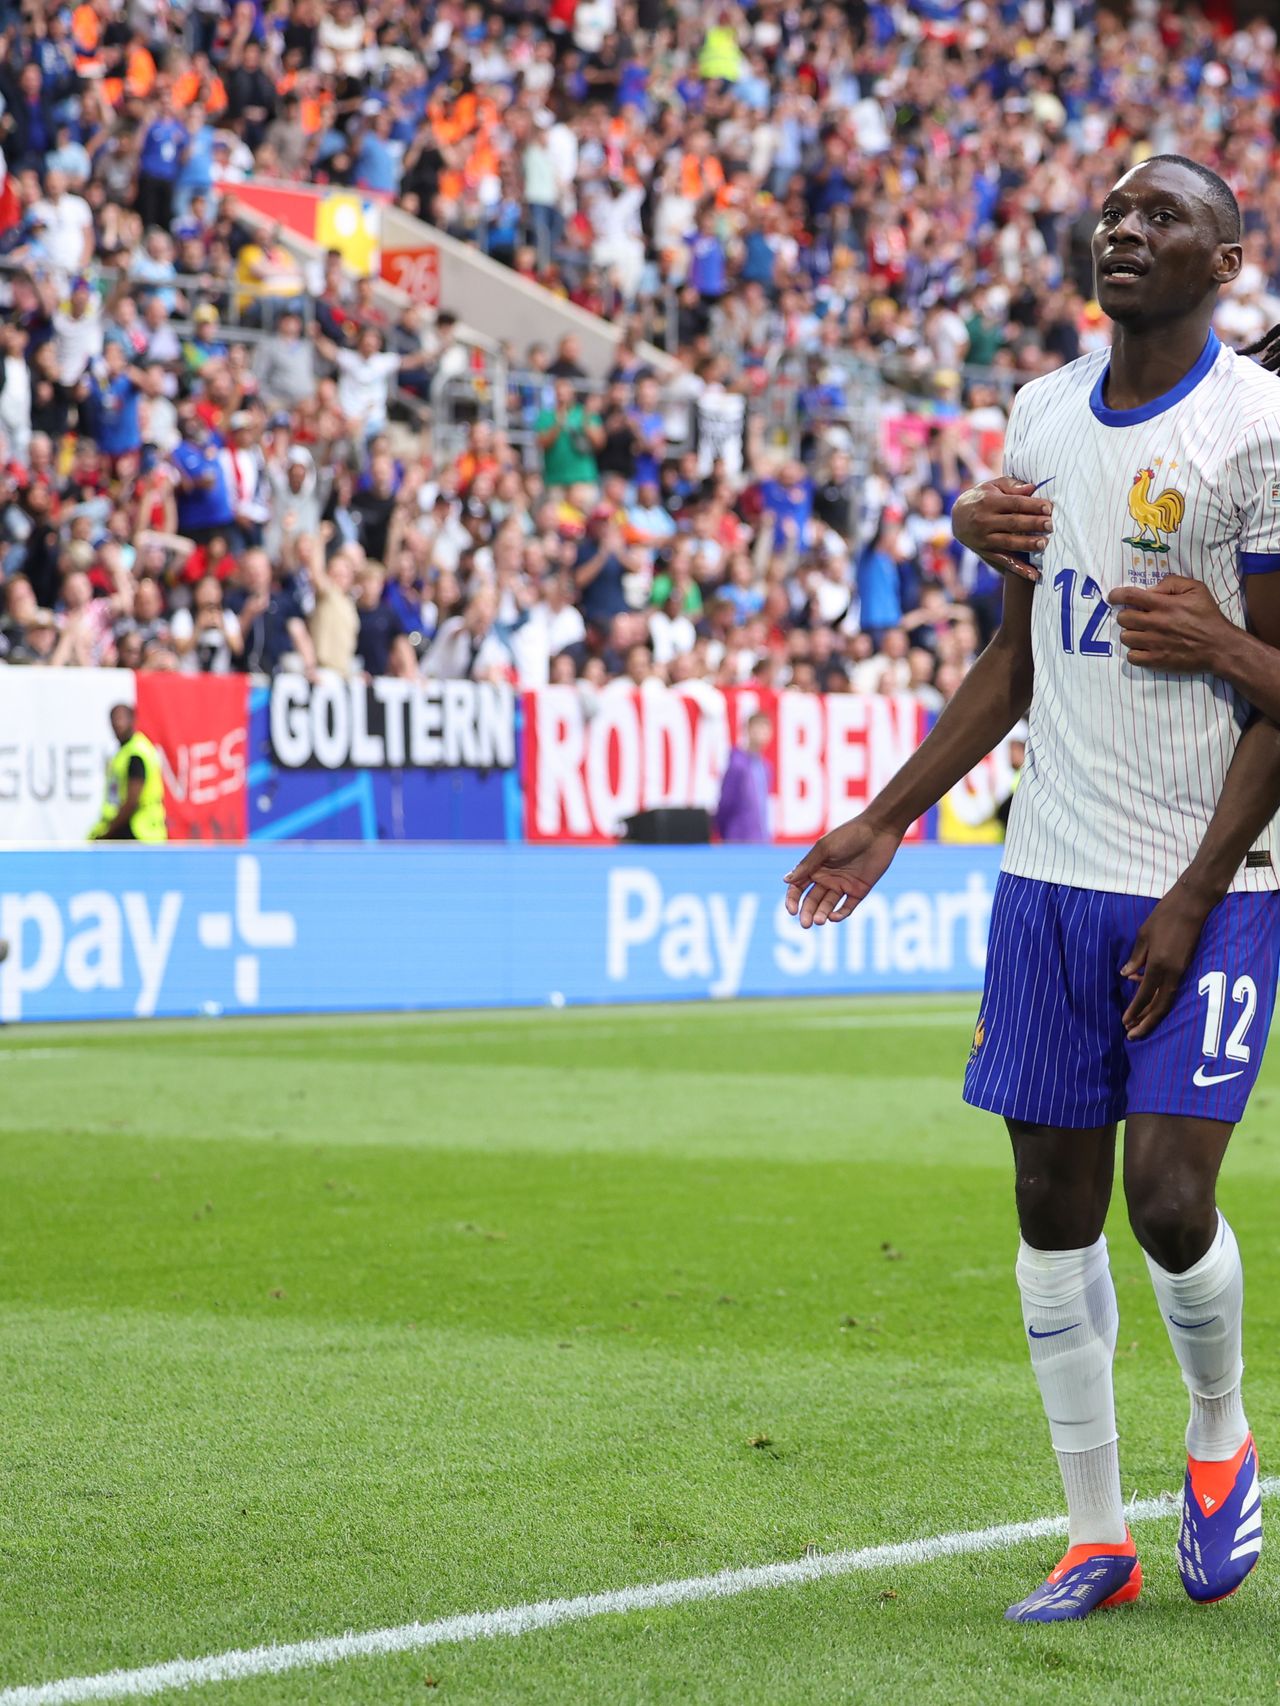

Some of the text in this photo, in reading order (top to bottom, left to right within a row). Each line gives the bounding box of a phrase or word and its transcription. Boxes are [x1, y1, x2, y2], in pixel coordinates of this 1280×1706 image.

[1053, 568, 1112, 657] 12
[270, 672, 515, 768] GOLTERN
[607, 867, 996, 999] Pay smart
[1198, 971, 1258, 1063] 12
